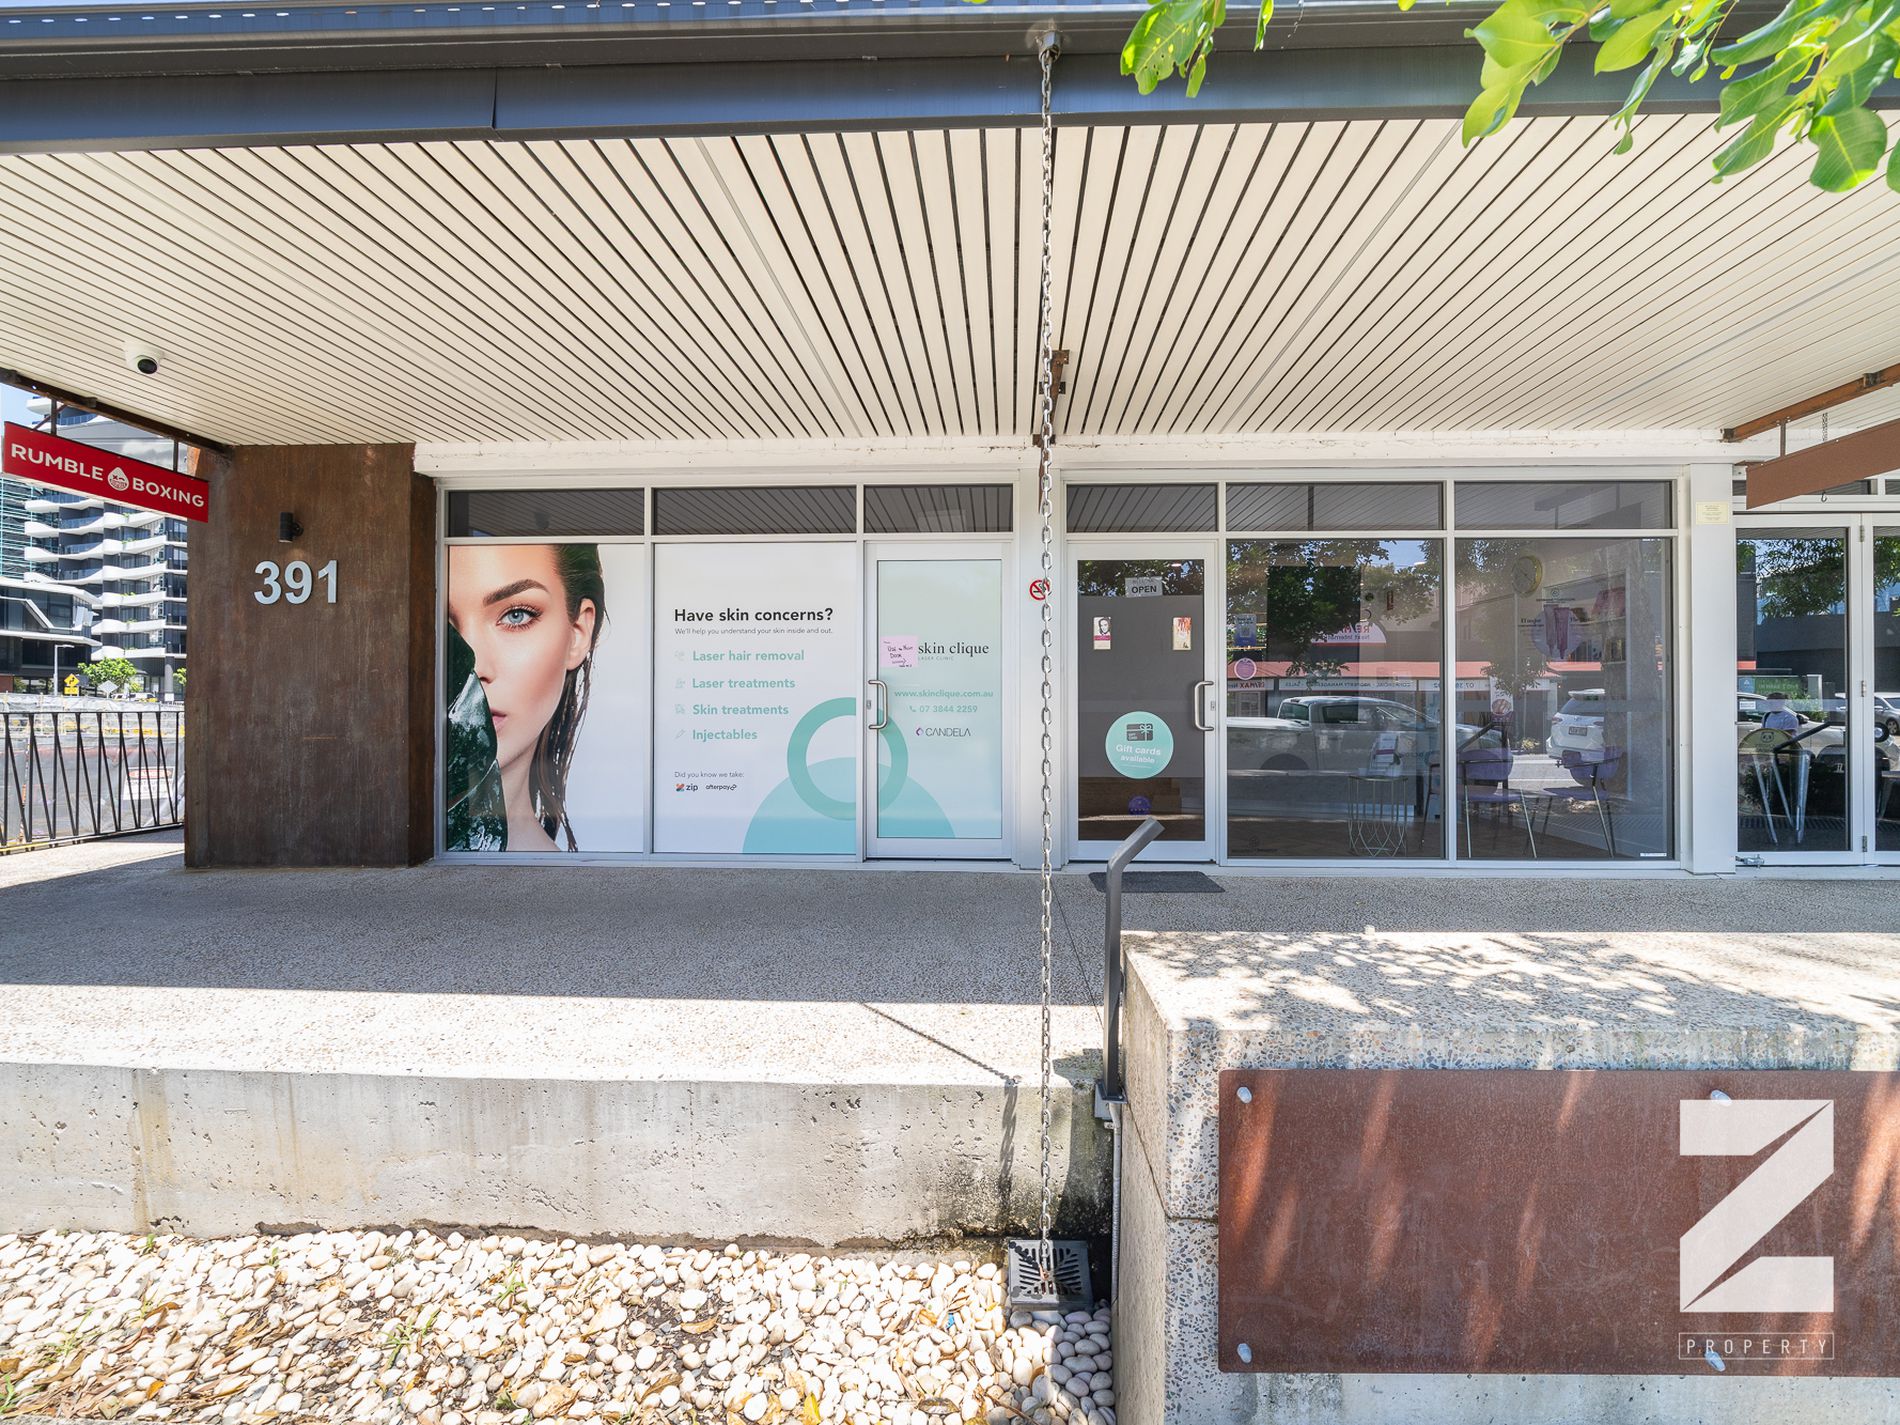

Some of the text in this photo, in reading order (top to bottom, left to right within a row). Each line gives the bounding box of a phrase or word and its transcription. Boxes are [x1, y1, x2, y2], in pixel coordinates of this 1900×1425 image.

[11, 443, 205, 507] RUMBLE BOXING
[253, 559, 338, 605] 391
[1131, 586, 1157, 594] OPEN
[674, 608, 833, 622] Have skin concerns?
[918, 642, 989, 657] skin clique
[693, 650, 805, 661] Laser hair removal
[692, 678, 795, 688] Laser treatments
[894, 689, 994, 699] www.skinclique.com.au
[692, 704, 789, 715] Skin treatments
[919, 705, 978, 713] 07 3844 2259
[692, 728, 758, 742] Injectables
[925, 727, 971, 737] CANDELA
[1115, 744, 1162, 756] Gift cards
[1120, 755, 1155, 763] available
[686, 783, 698, 792] zip
